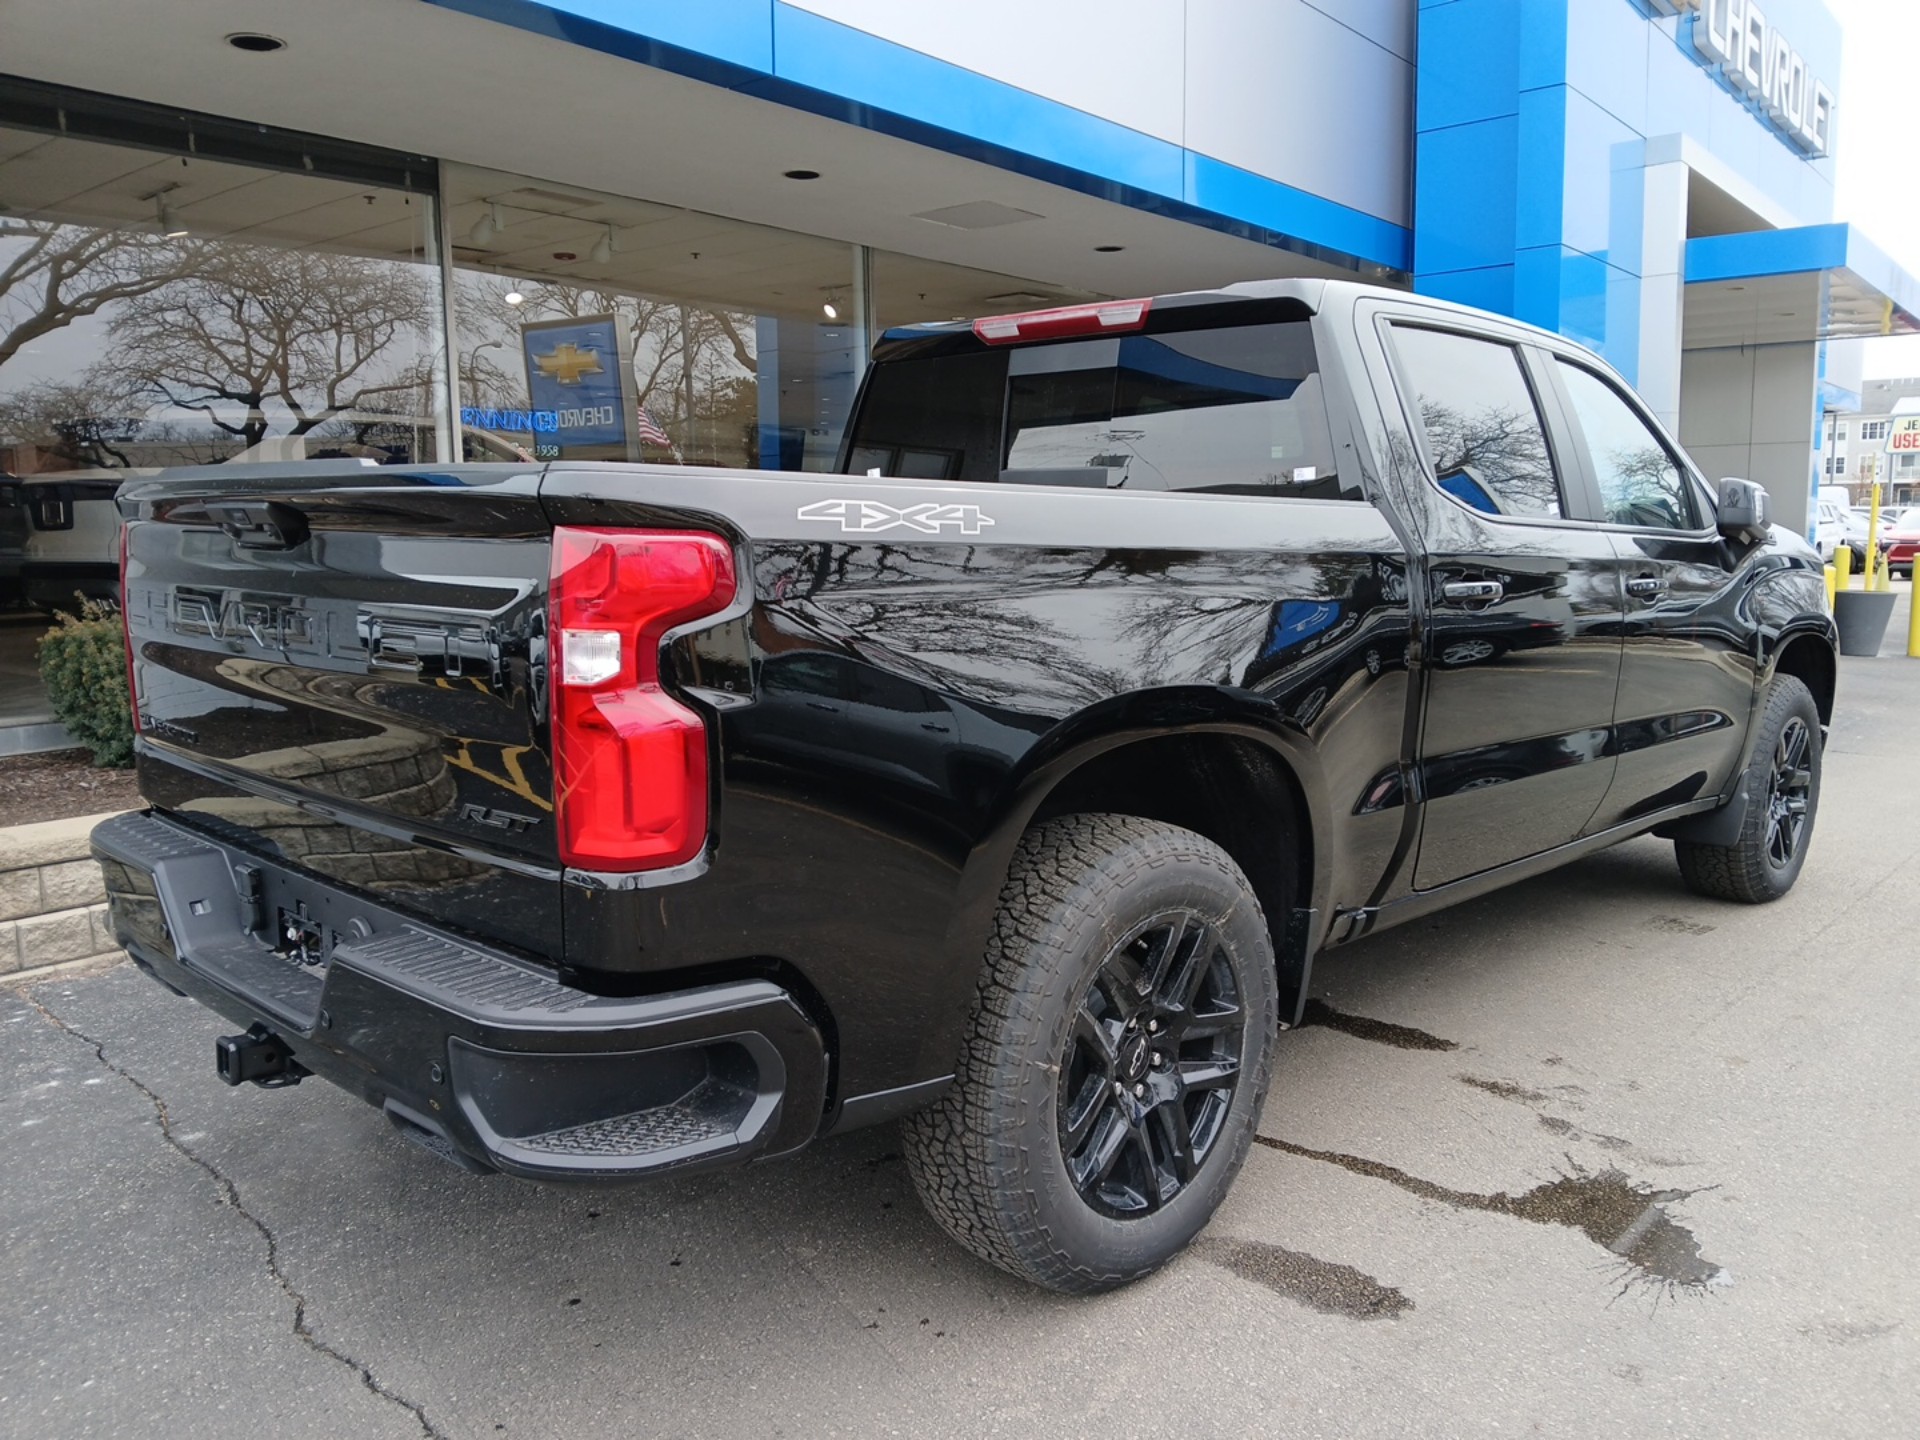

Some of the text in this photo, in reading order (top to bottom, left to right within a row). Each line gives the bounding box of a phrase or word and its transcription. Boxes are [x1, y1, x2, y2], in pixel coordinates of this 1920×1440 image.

[1695, 0, 1836, 158] CHEVROLET
[462, 407, 559, 432] ENNINGS
[536, 445, 559, 457] 1958
[1893, 432, 1920, 449] USE
[127, 586, 491, 677] CHEVROLET
[459, 802, 543, 833] RST
